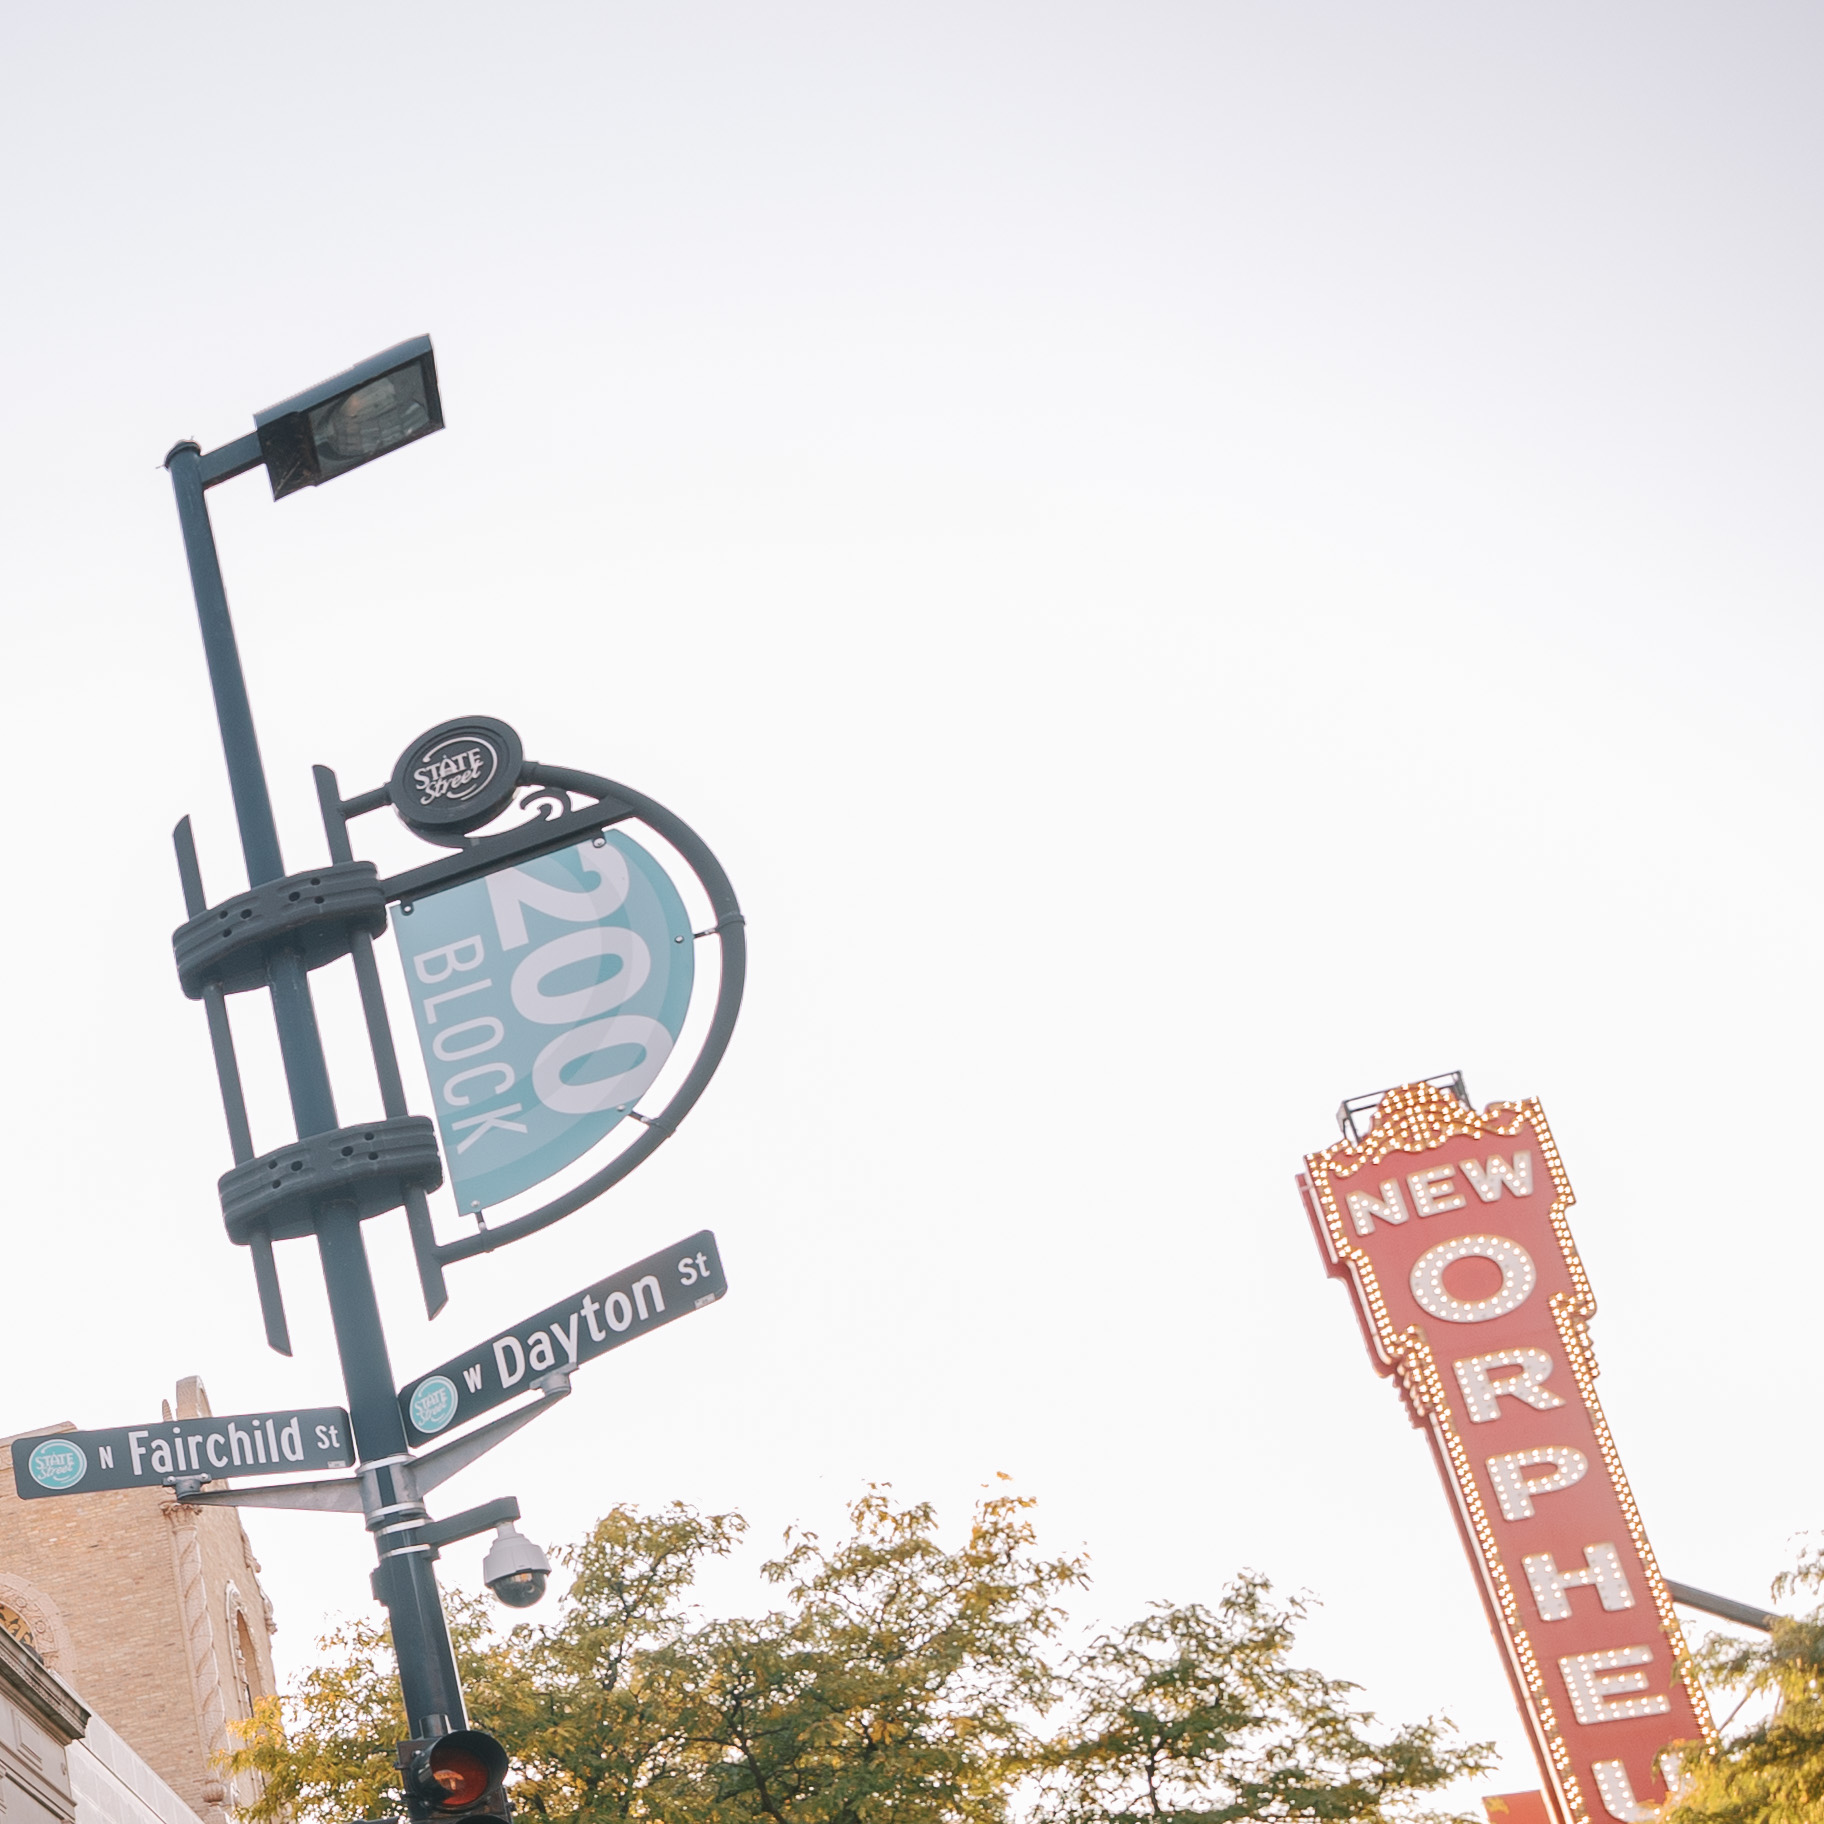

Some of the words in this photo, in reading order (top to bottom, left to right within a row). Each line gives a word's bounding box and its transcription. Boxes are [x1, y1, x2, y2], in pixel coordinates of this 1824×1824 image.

[413, 748, 481, 789] STATE
[420, 760, 484, 805] Street
[484, 843, 675, 1115] 200
[413, 934, 528, 1155] BLOCK
[1345, 1150, 1534, 1236] NEW
[462, 1363, 483, 1394] W
[492, 1275, 666, 1389] Dayton
[677, 1251, 711, 1286] St
[98, 1446, 115, 1470] N
[127, 1416, 305, 1476] Fairchild
[314, 1424, 341, 1450] St
[1409, 1234, 1696, 1824] ORPHEU
